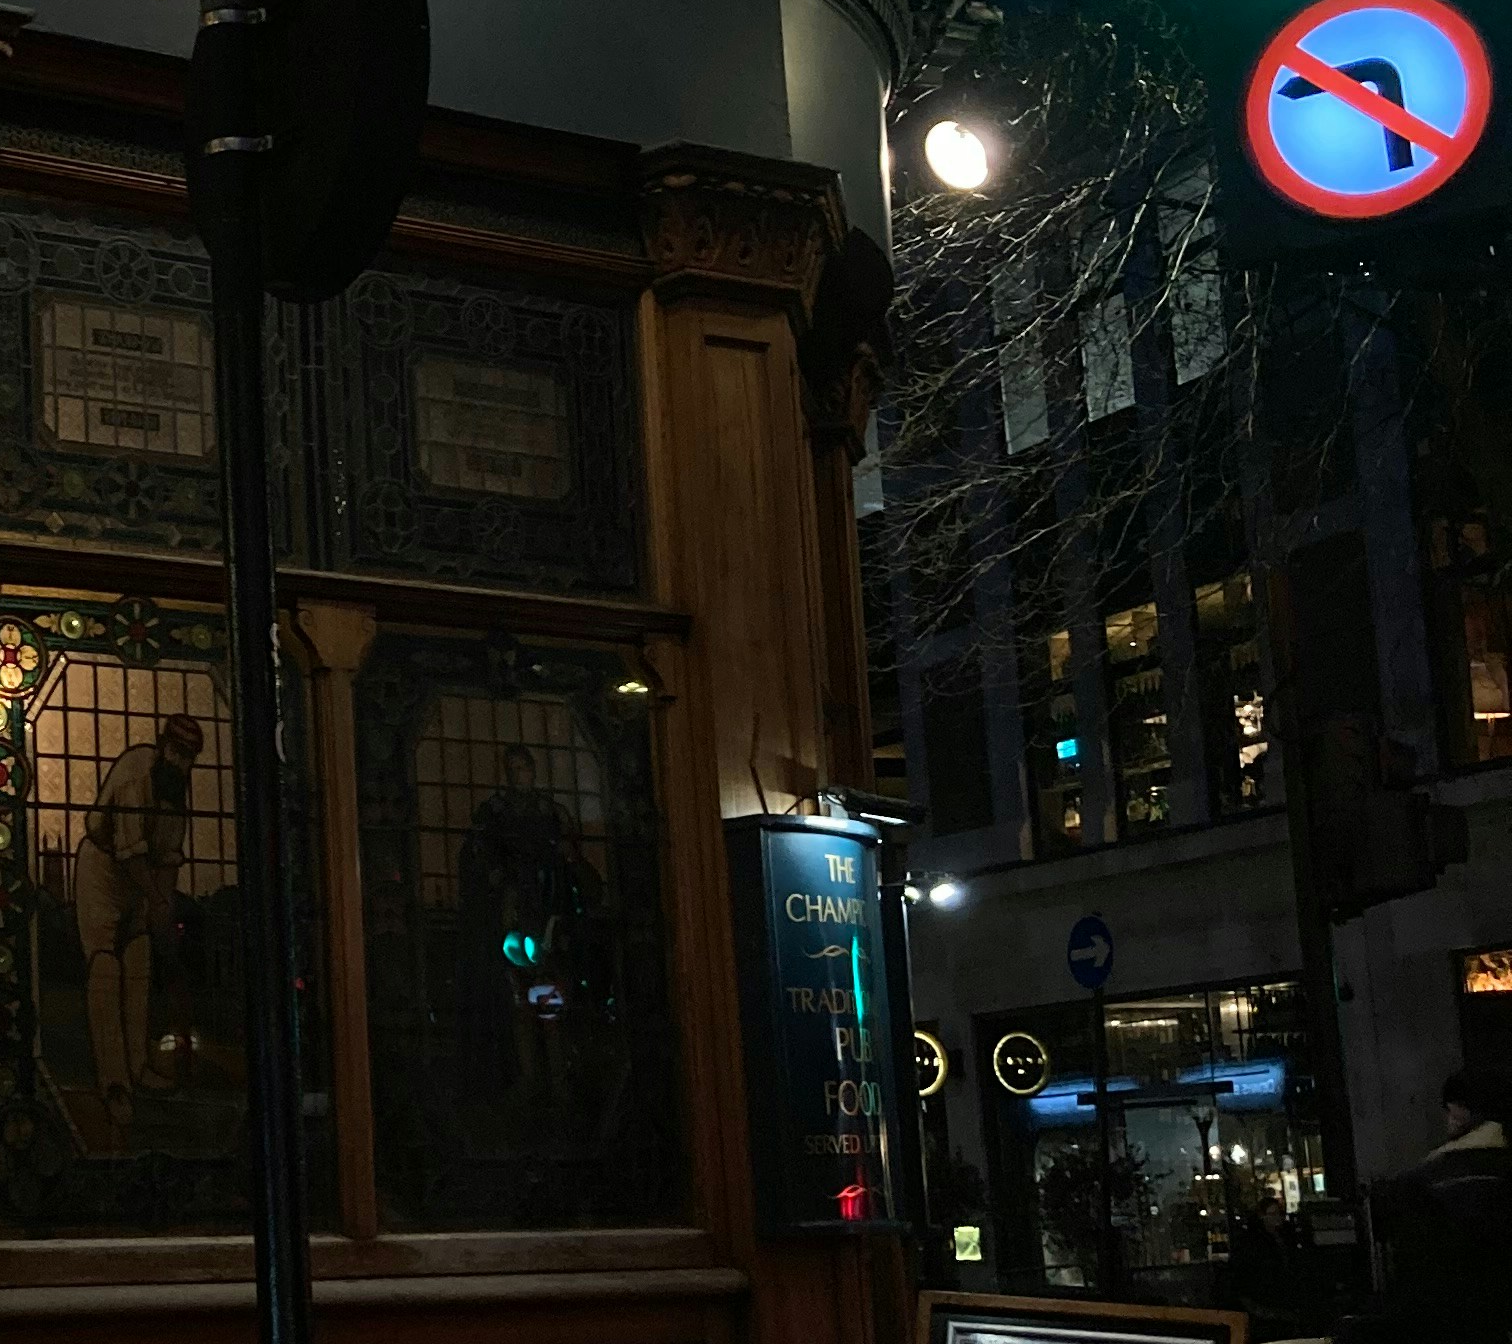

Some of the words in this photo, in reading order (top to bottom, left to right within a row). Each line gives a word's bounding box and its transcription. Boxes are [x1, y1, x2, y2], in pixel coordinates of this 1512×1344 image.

[825, 853, 856, 884] THE
[835, 1027, 872, 1063] PUB
[824, 1080, 882, 1117] FOOD
